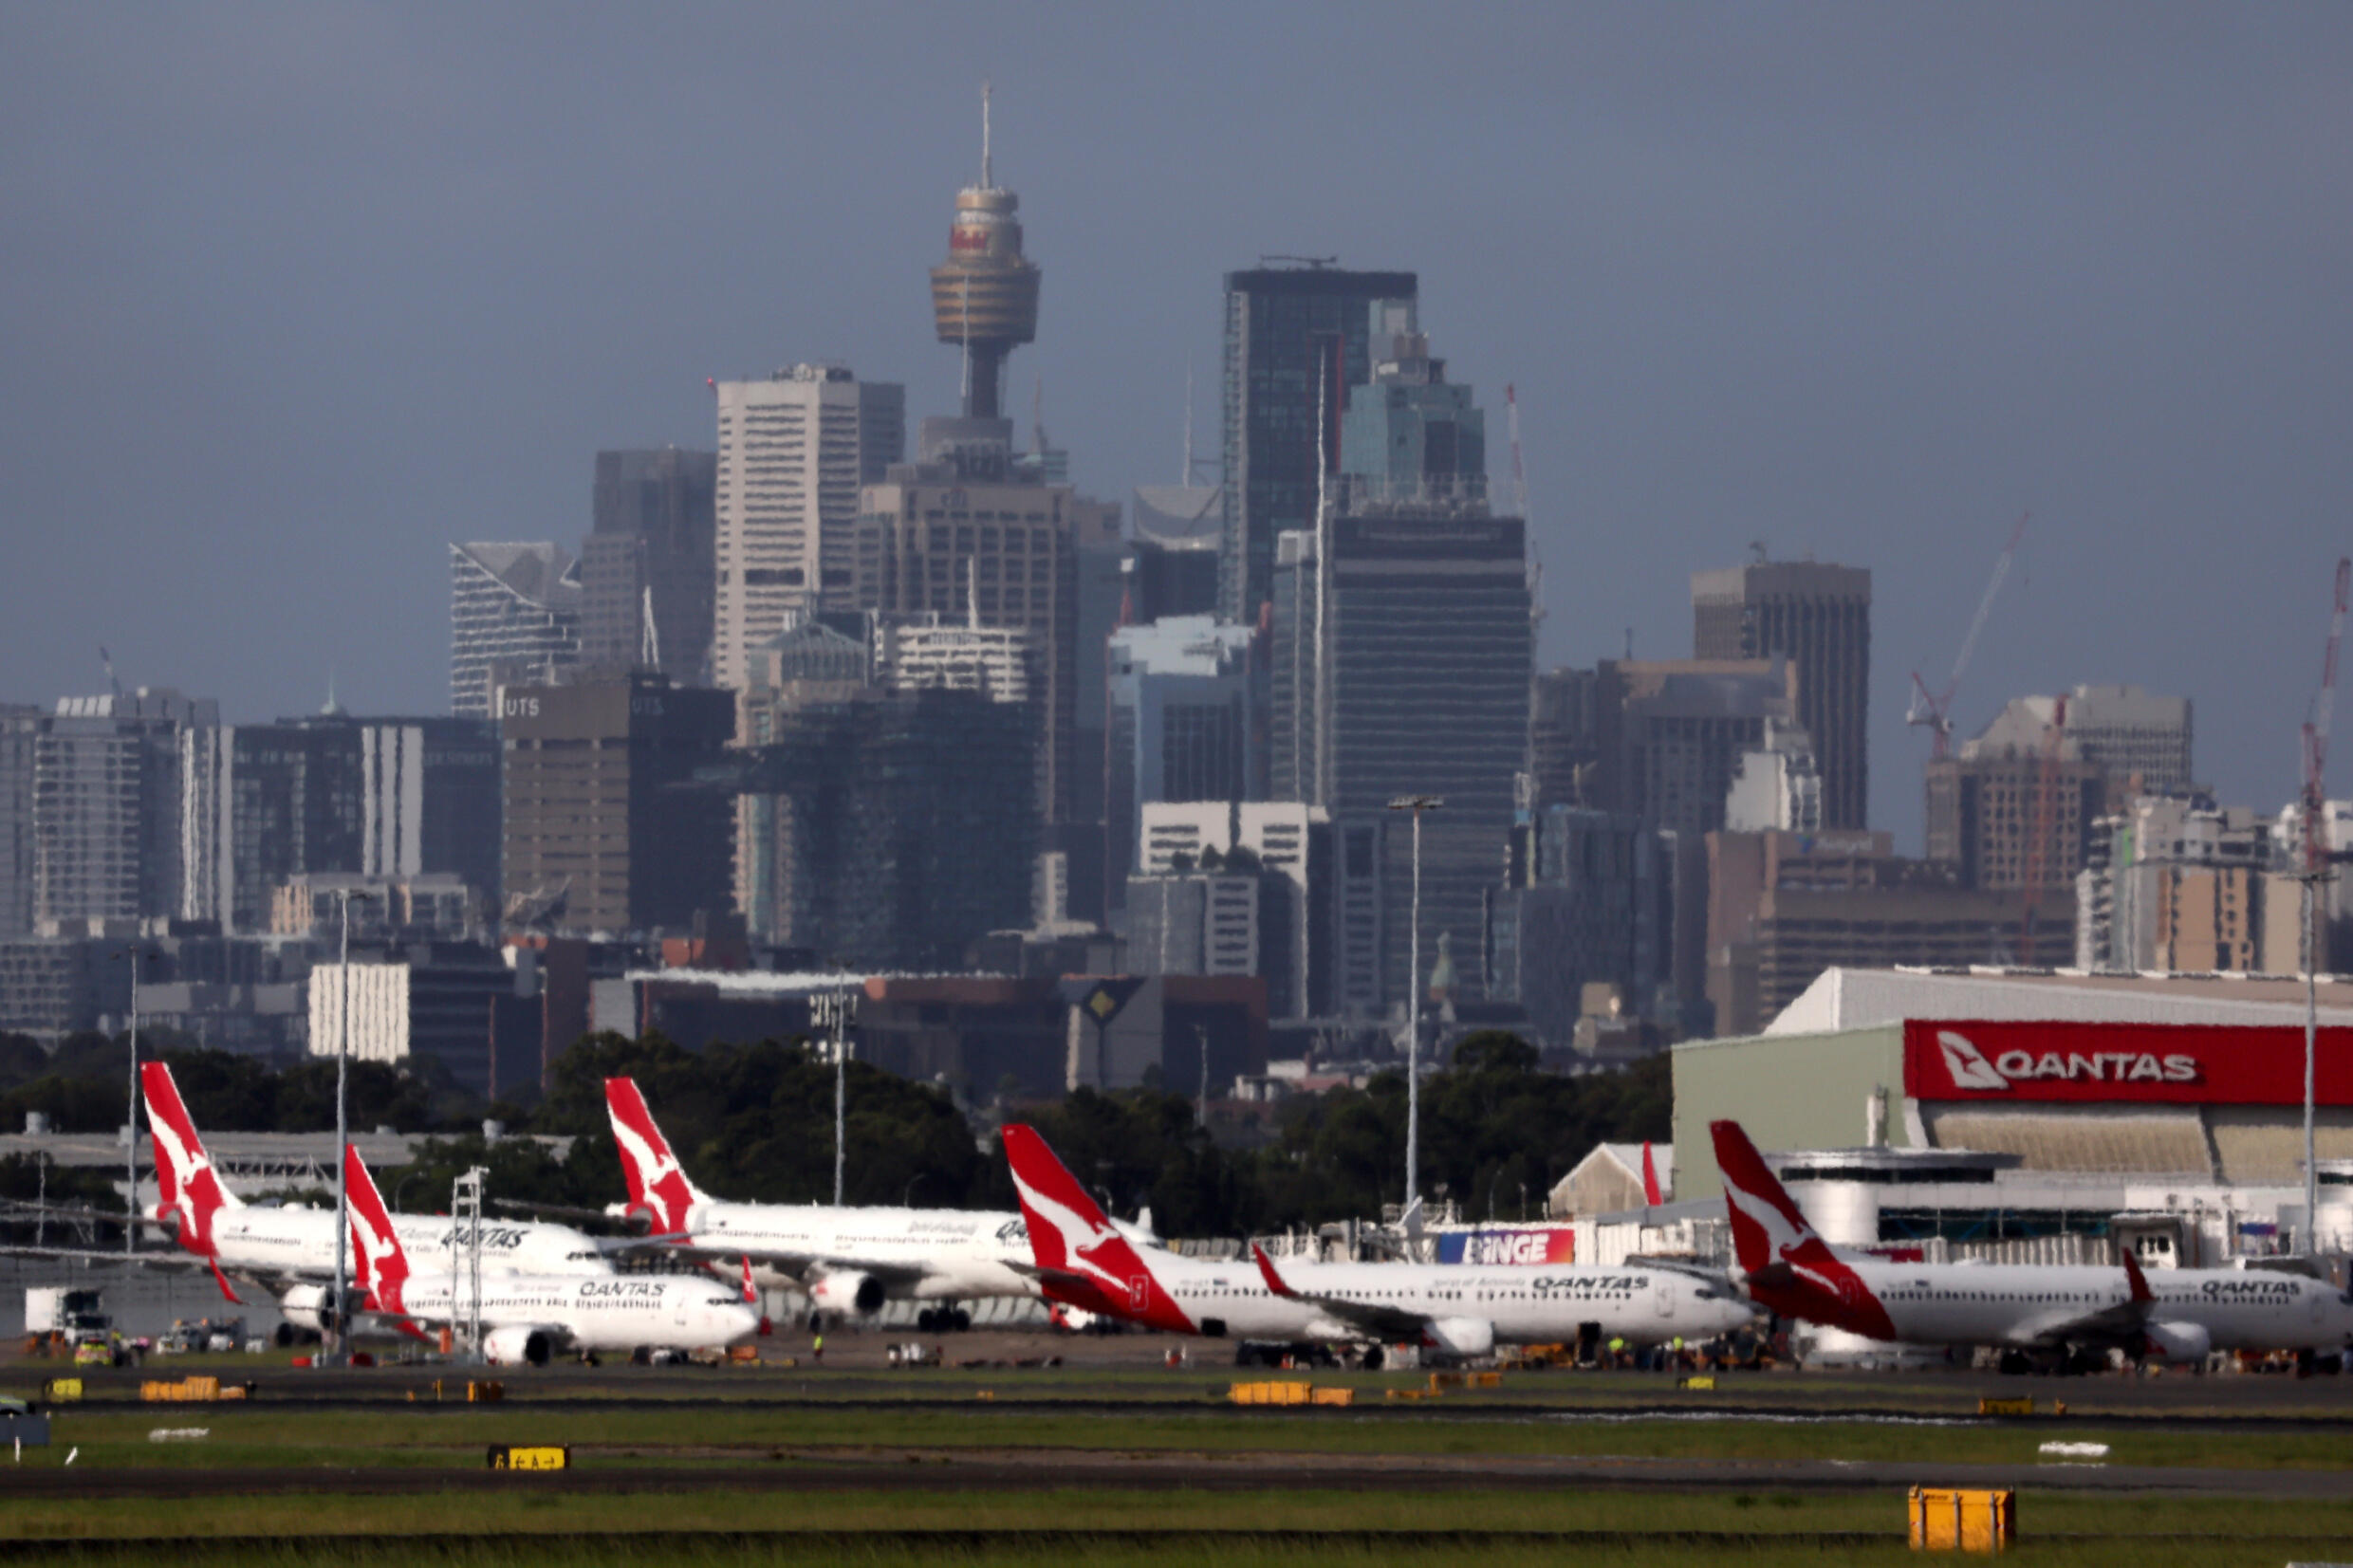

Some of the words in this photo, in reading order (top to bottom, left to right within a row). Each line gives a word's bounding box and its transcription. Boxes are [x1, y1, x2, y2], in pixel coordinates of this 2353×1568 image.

[506, 697, 540, 717] UTS
[1996, 1050, 2196, 1080] QANTAS
[579, 1281, 666, 1297] QANTAS
[1533, 1276, 1649, 1291] QANTAS
[2201, 1281, 2301, 1297] QANTAS
